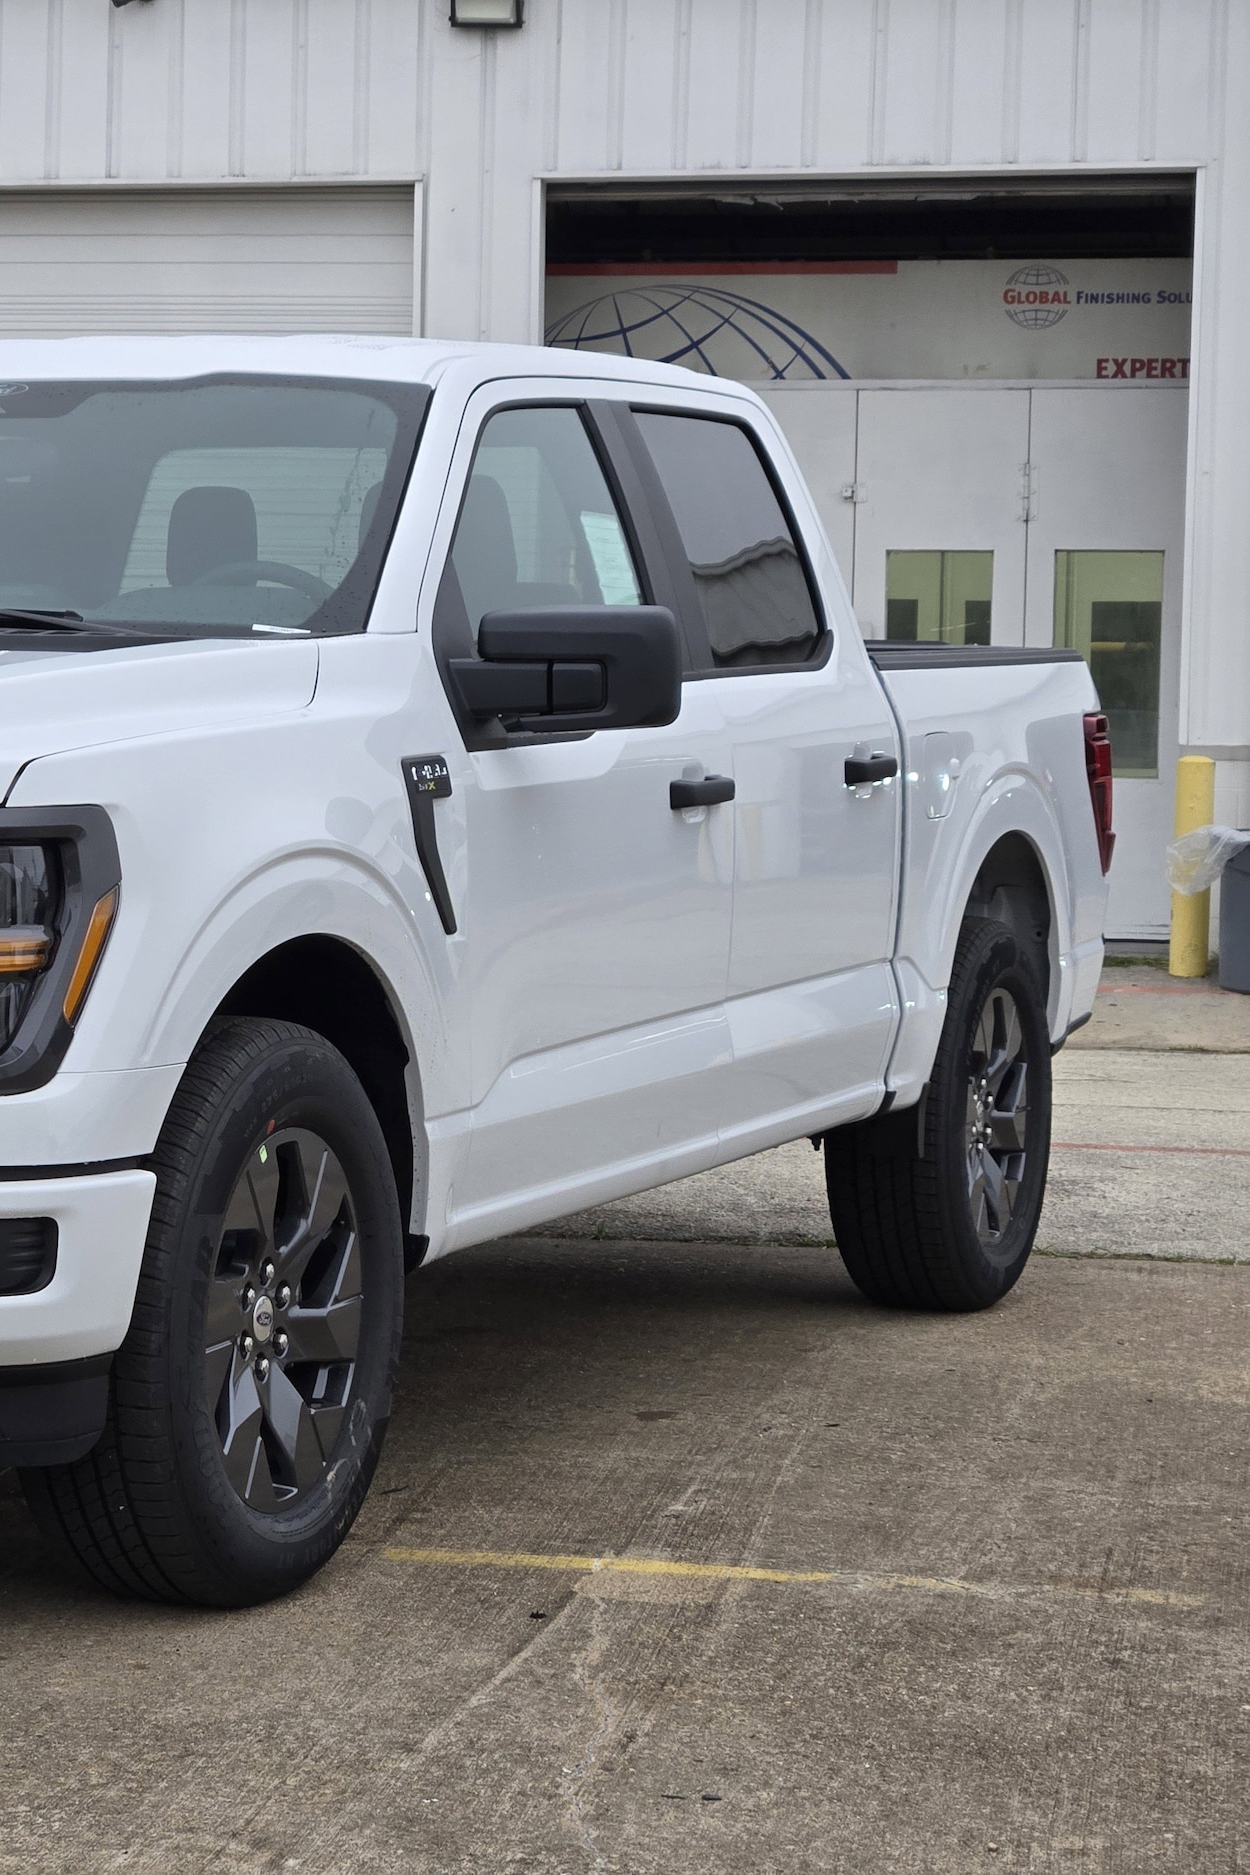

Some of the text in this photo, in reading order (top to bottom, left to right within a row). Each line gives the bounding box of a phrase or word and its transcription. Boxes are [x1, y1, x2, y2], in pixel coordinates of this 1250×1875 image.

[1003, 288, 1071, 305] GLOBAL
[1076, 290, 1152, 305] FINISHING
[1096, 358, 1190, 379] EXPERT
